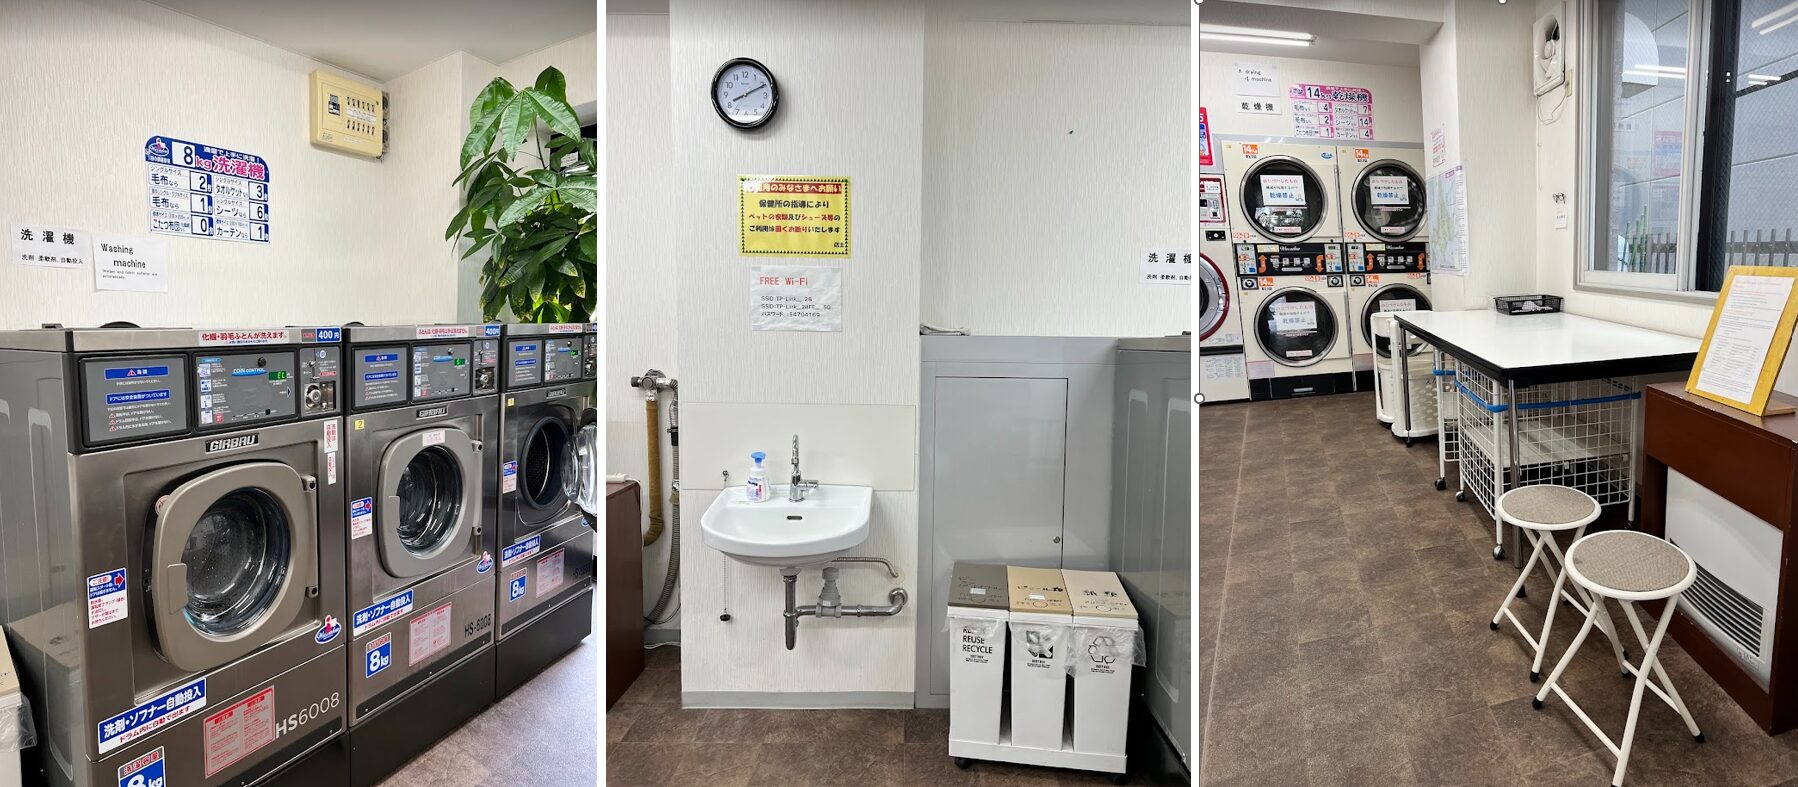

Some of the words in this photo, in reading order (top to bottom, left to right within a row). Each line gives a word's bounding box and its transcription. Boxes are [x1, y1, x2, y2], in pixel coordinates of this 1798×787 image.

[1307, 87, 1320, 98] 14
[1324, 115, 1330, 124] 2
[1359, 118, 1368, 126] 14
[184, 146, 193, 165] 8
[195, 157, 212, 169] kg
[213, 155, 264, 179] 洗濯機
[151, 173, 178, 188] 毛布なら
[199, 176, 206, 190] 2
[257, 185, 263, 198] 3
[152, 196, 179, 210] 毛布なら
[200, 198, 205, 212] 1
[759, 199, 829, 208] 保健所の指導により
[257, 206, 263, 219] 6
[201, 218, 207, 232] 0
[20, 228, 74, 245] 洗濯機
[257, 226, 262, 239] 1
[101, 243, 134, 254] Washing
[113, 259, 146, 268] machine
[759, 276, 780, 286] FREE
[785, 277, 808, 286] Wi-Fi
[318, 330, 340, 339] 400円
[209, 434, 256, 452] GIRBAU
[963, 635, 985, 644] REUSE
[963, 644, 992, 654] RECYCLE
[103, 686, 202, 738] 洗剤・ソフナー自動投入
[276, 692, 340, 738] HS6008
[120, 706, 190, 742] ドラム内に自動で出ます
